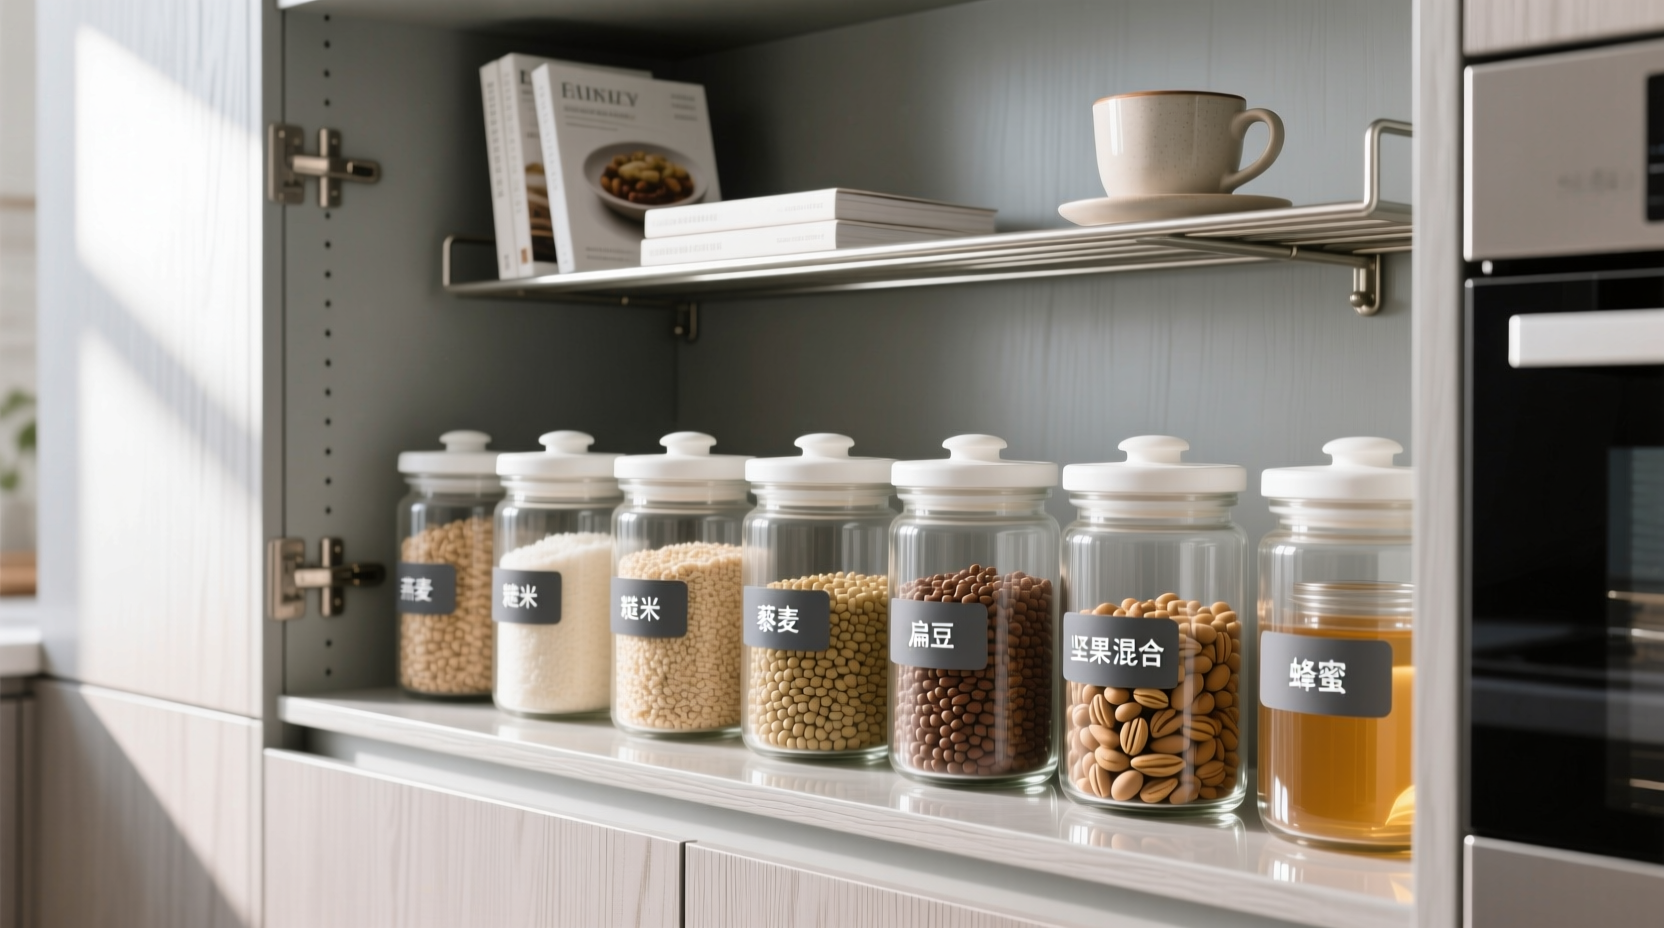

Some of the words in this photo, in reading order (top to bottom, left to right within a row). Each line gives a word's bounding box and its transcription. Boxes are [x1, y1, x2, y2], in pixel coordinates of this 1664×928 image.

[620, 595, 660, 622] 糙米
[756, 604, 799, 634] 藜麦
[908, 619, 955, 649] 扁豆
[1070, 633, 1164, 668] 坚果混合
[1288, 656, 1346, 695] 蜂蜜
